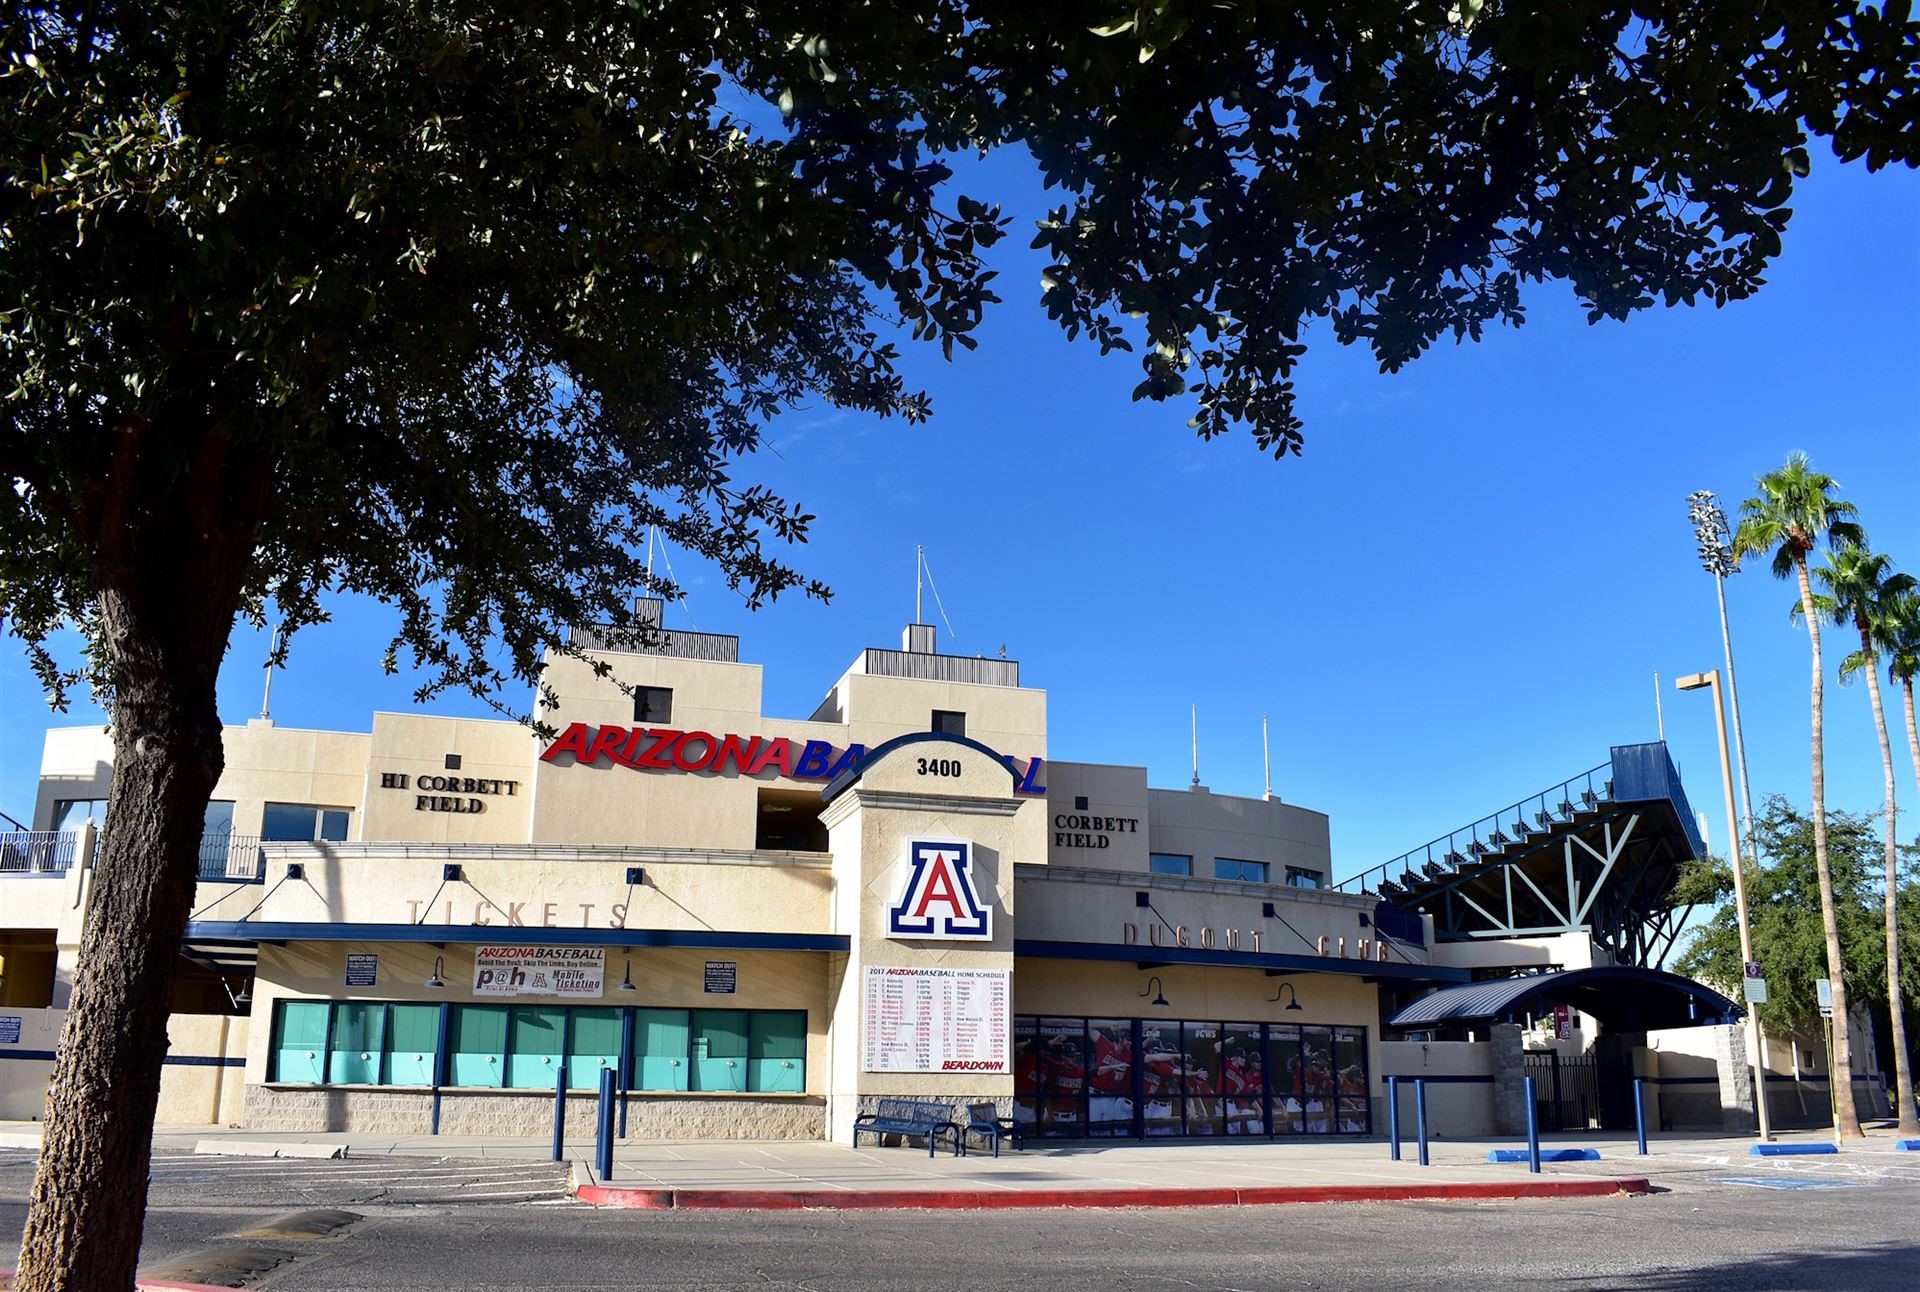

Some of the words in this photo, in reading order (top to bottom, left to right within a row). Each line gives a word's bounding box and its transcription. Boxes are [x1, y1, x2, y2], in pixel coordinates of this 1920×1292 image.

[539, 722, 792, 777] ARIZONA
[917, 757, 961, 778] 3400
[380, 772, 408, 790] HI
[416, 775, 519, 796] CORBETT
[415, 795, 485, 814] FIELD
[1054, 814, 1139, 833] CORBETT
[1054, 832, 1110, 849] FIELD
[406, 900, 628, 929] TICKETS
[1122, 922, 1264, 953] DUGOUT
[1316, 935, 1390, 962] CLUB
[478, 947, 535, 959] ARIZONA
[535, 948, 603, 960] BASEBALL
[552, 969, 585, 980] Mobile
[886, 968, 919, 976] ARIZONA
[556, 979, 600, 989] Ticketing
[1195, 1029, 1217, 1039] #CWS
[942, 1060, 1004, 1070] BEARDOWN
